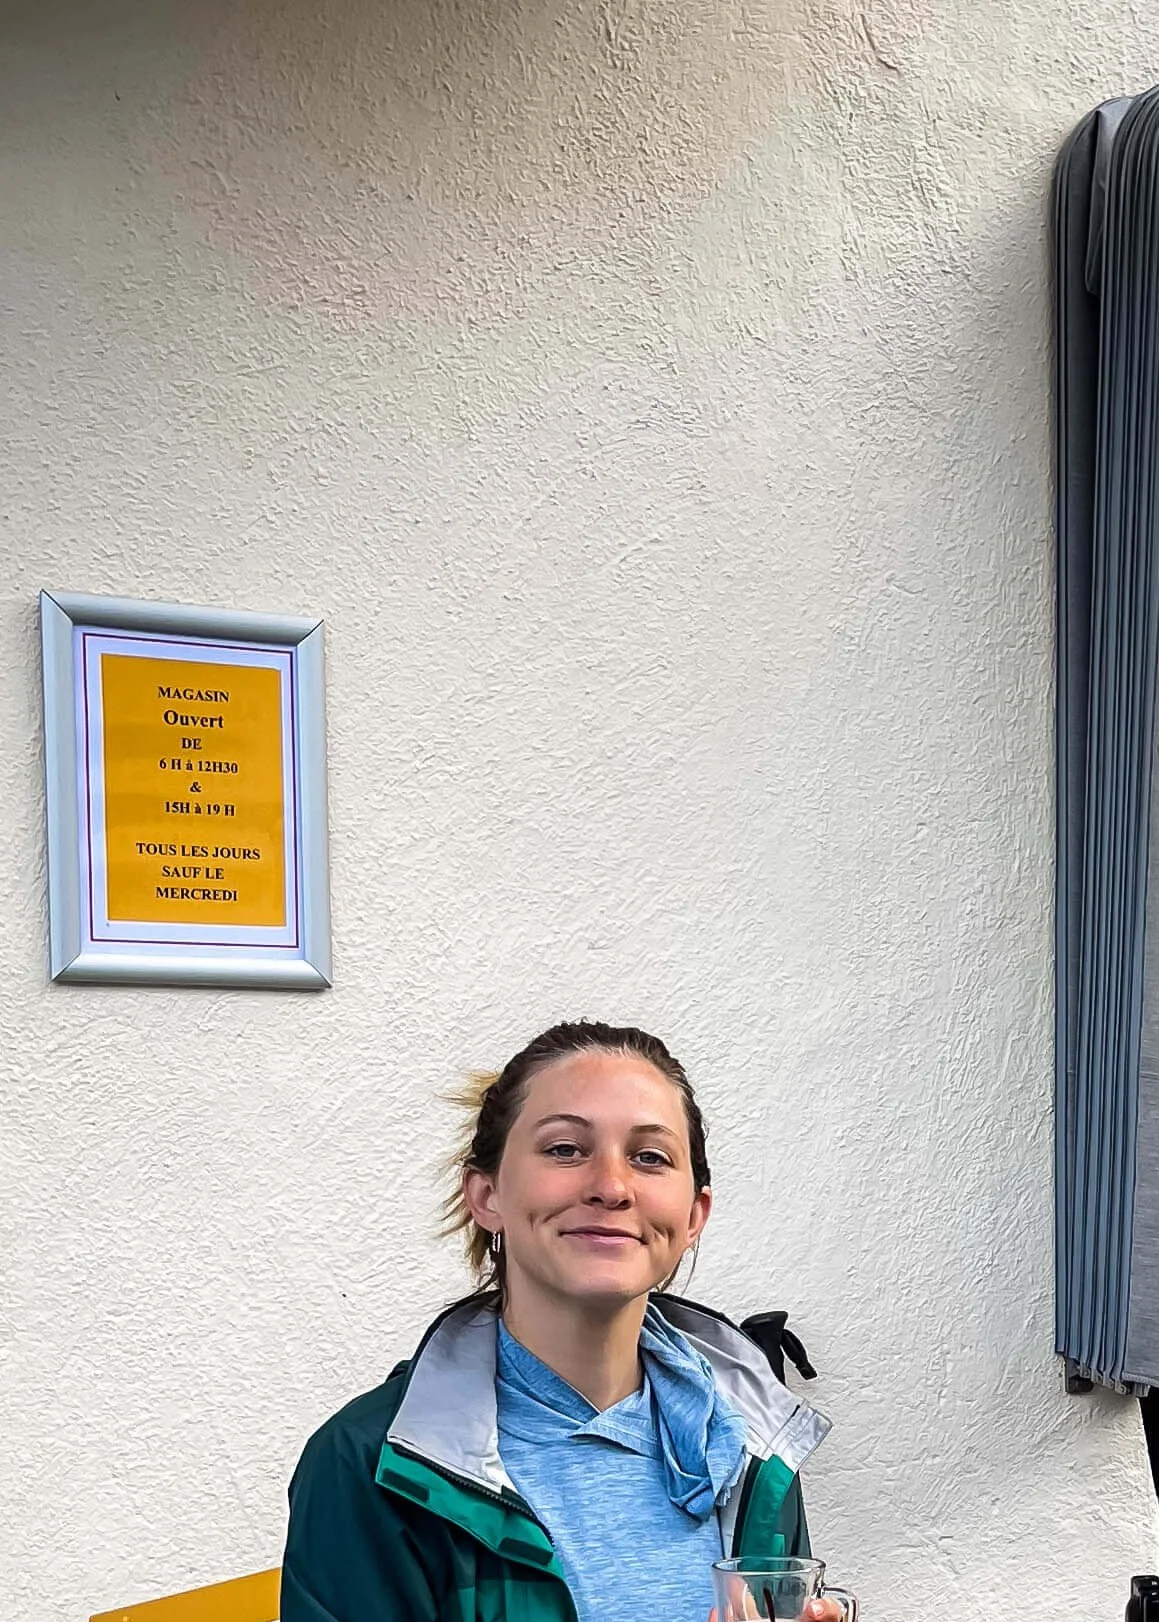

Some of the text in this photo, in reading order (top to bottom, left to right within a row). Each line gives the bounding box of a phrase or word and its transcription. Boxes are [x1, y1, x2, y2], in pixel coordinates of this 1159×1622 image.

[157, 686, 229, 703] MAGASIN
[163, 709, 224, 729] Ouvert
[181, 737, 203, 752] DE
[159, 757, 238, 774] 6 H à 12H30
[189, 781, 202, 793] &
[165, 801, 235, 817] 15H à 19 H
[135, 842, 261, 861] TOUS LES JOURS
[161, 865, 225, 881] SAUF LE
[156, 886, 238, 903] MERCREDI
